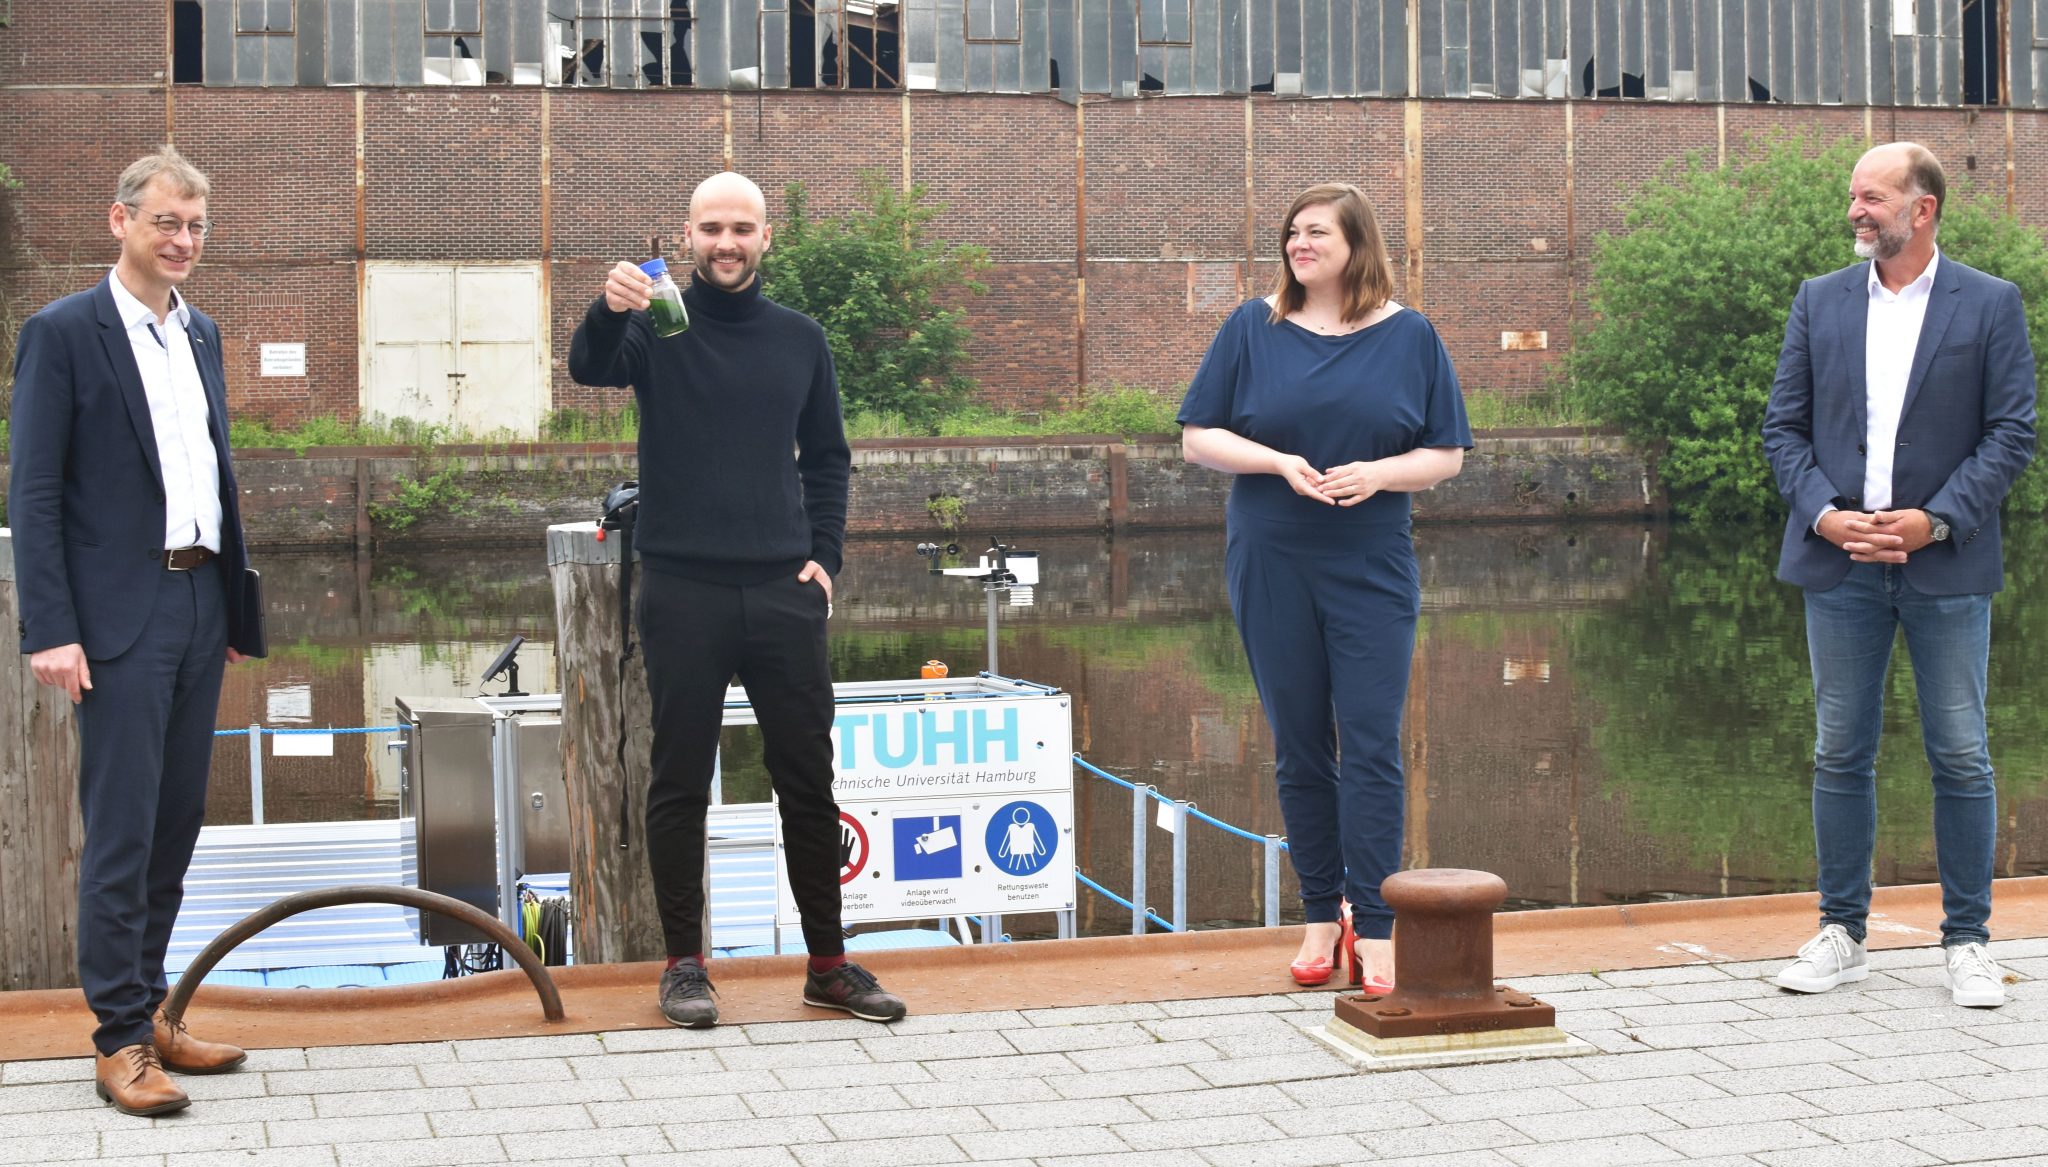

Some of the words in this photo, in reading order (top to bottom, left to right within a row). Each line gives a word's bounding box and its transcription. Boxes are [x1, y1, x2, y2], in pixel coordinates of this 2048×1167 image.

[833, 708, 1019, 770] TUHH
[832, 776, 891, 790] chnische
[896, 771, 970, 787] Universität
[975, 769, 1036, 785] Hamburg
[997, 883, 1049, 891] Rettungsweste
[843, 893, 868, 901] Anlage
[906, 889, 931, 897] Anlage
[901, 897, 957, 907] videoüberwacht
